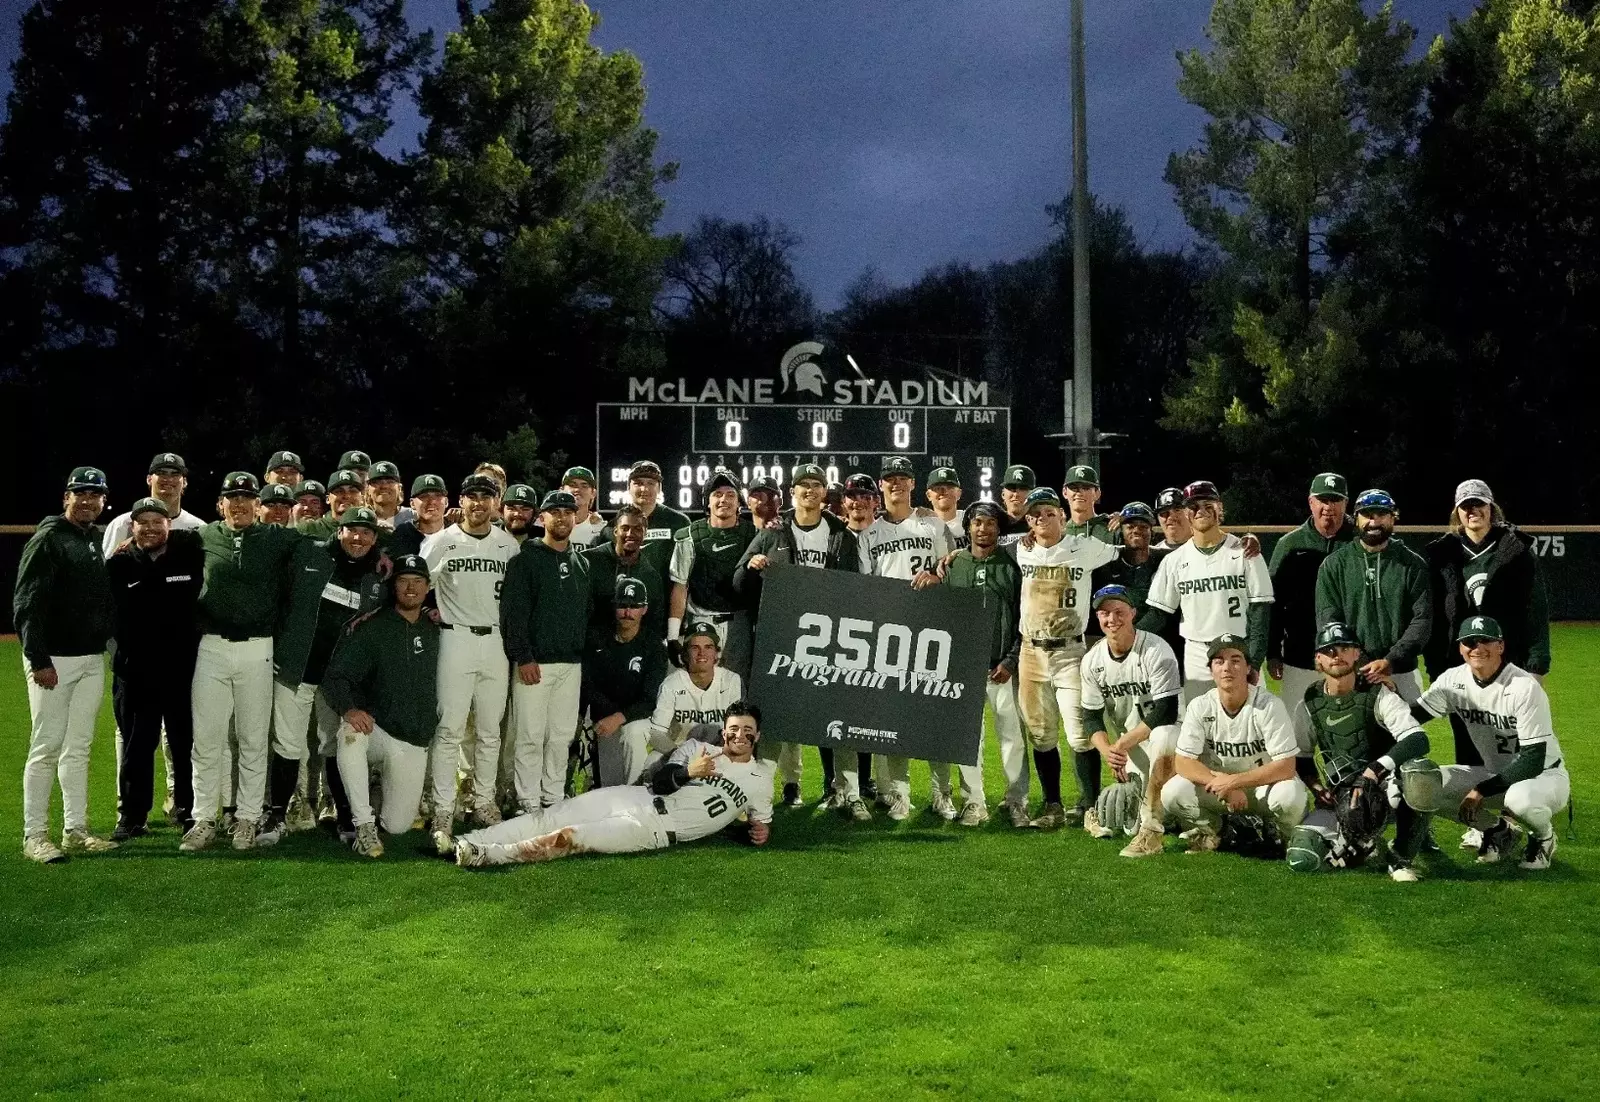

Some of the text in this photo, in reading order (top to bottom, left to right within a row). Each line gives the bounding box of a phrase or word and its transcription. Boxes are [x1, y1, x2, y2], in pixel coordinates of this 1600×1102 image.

[628, 376, 988, 405] McLANE STADIUM
[620, 407, 648, 420] MPH
[717, 408, 749, 421] BALL
[797, 408, 843, 422] STRIKE
[888, 409, 914, 422] OUT
[955, 410, 997, 424] AT BAT
[725, 421, 741, 447] 0
[812, 422, 828, 447] 0
[893, 422, 910, 448] 0
[683, 454, 859, 466] 1 2 3 4 5 6 7 8 9 10
[932, 456, 954, 467] HITS
[976, 456, 995, 467] ERR
[679, 465, 692, 486] 0
[696, 465, 709, 486] 0
[980, 467, 992, 487] 2
[679, 487, 692, 508] 0
[869, 536, 933, 560] SPARTANS
[447, 558, 508, 574] SPARTAN
[909, 555, 935, 576] 24
[1021, 564, 1083, 580] SPARTANS
[1177, 574, 1246, 595] SPARTANS
[1057, 587, 1076, 608] 18
[1228, 596, 1241, 618] 2
[794, 612, 952, 681] 2500
[767, 653, 965, 700] Program Wins
[674, 709, 725, 724] SPARTAN
[703, 794, 728, 819] 10
